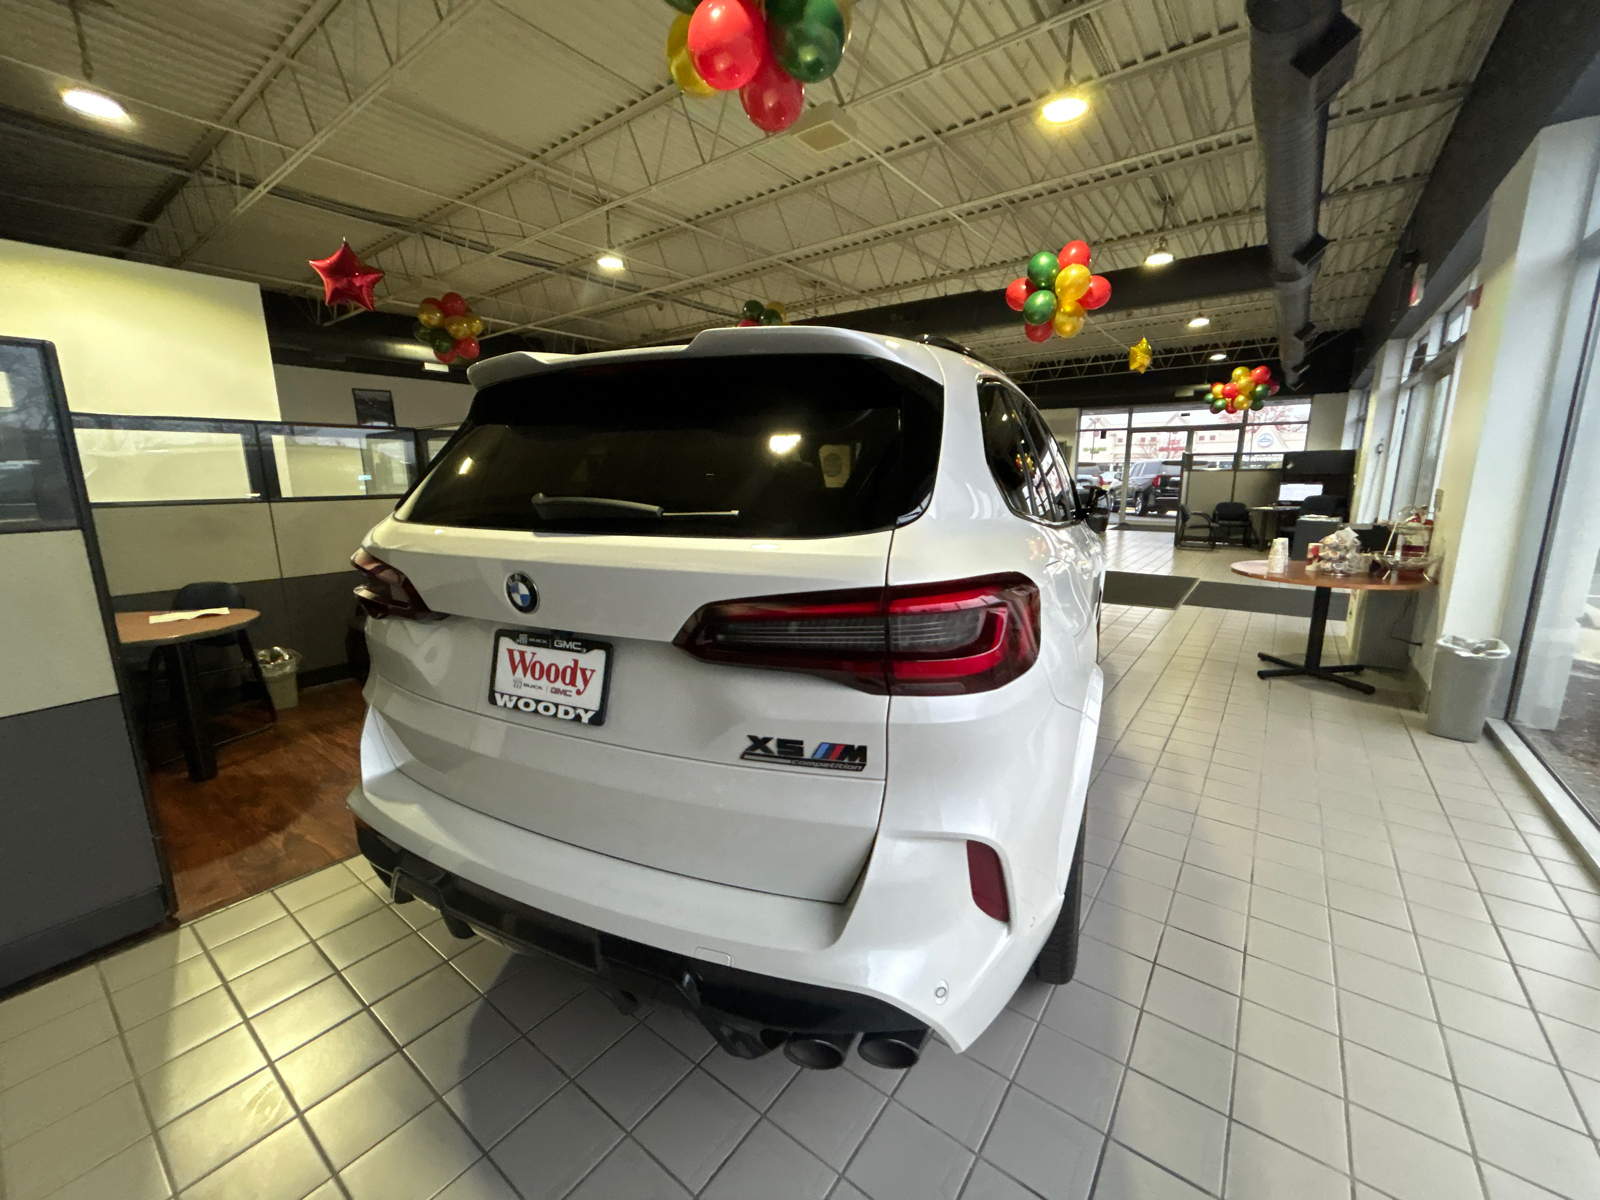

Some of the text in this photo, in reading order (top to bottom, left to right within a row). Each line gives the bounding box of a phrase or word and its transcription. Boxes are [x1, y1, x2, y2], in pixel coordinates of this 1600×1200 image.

[554, 639, 582, 651] GMC
[506, 648, 596, 696] Woody
[523, 682, 573, 697] BUICK GMC
[494, 692, 597, 724] WOODY
[745, 734, 804, 757] X5
[791, 759, 863, 771] competition
